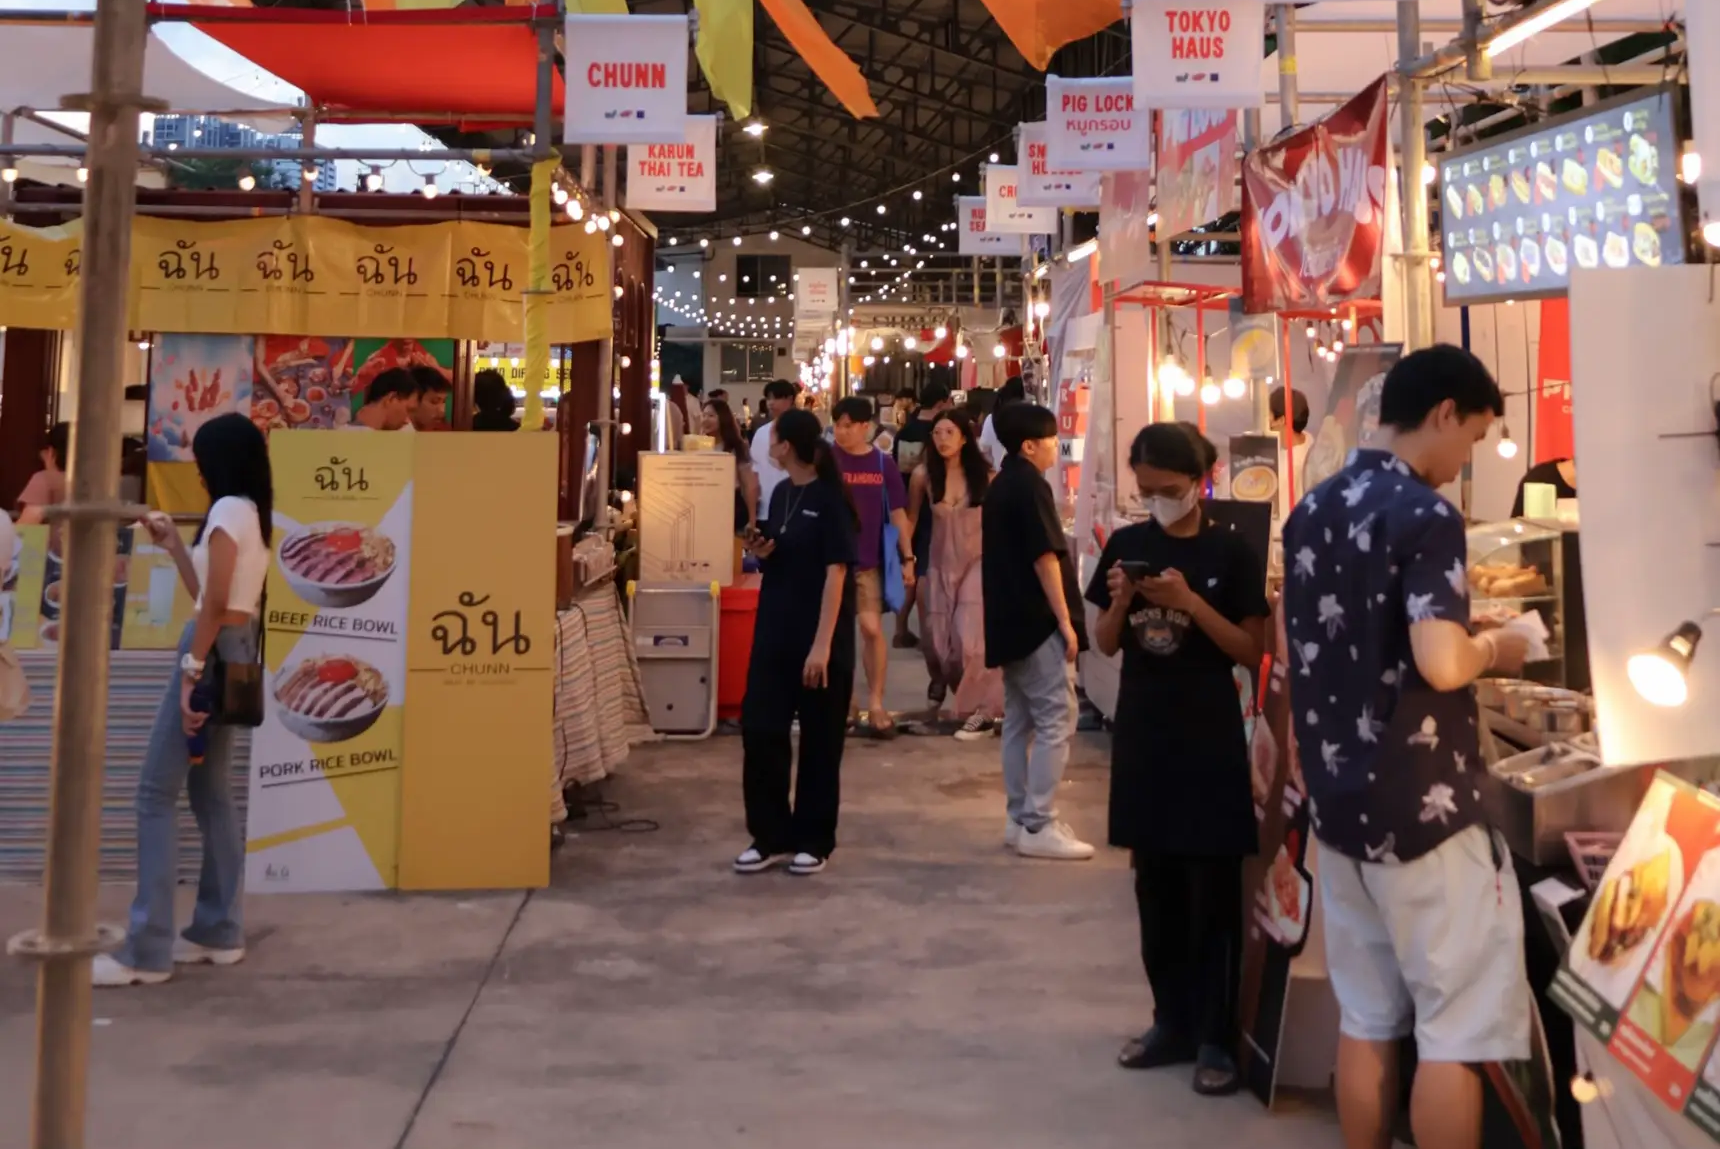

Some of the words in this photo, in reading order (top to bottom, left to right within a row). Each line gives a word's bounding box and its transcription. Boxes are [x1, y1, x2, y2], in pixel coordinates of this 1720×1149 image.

[1166, 10, 1231, 32] TOKYO
[1171, 37, 1224, 59] HAUS
[587, 62, 666, 88] CHUNN
[1061, 94, 1088, 112] PIG
[1066, 118, 1132, 137] หมูกรอบ
[648, 144, 695, 159] KARUN
[639, 161, 670, 177] THAI
[678, 162, 704, 177] TEA
[158, 239, 219, 280] ฉัน
[356, 243, 418, 285] ฉัน
[456, 246, 513, 291] ฉัน
[552, 251, 594, 293] ฉัน
[315, 456, 369, 492] ฉัน
[268, 610, 309, 625] BEEF
[313, 614, 348, 630] RICE
[352, 617, 398, 634] BOWL
[431, 591, 531, 655] ฉัน
[450, 662, 511, 675] CHUNN
[259, 762, 304, 779] PORK
[310, 755, 345, 772] RICE
[350, 749, 397, 766] BOWL
